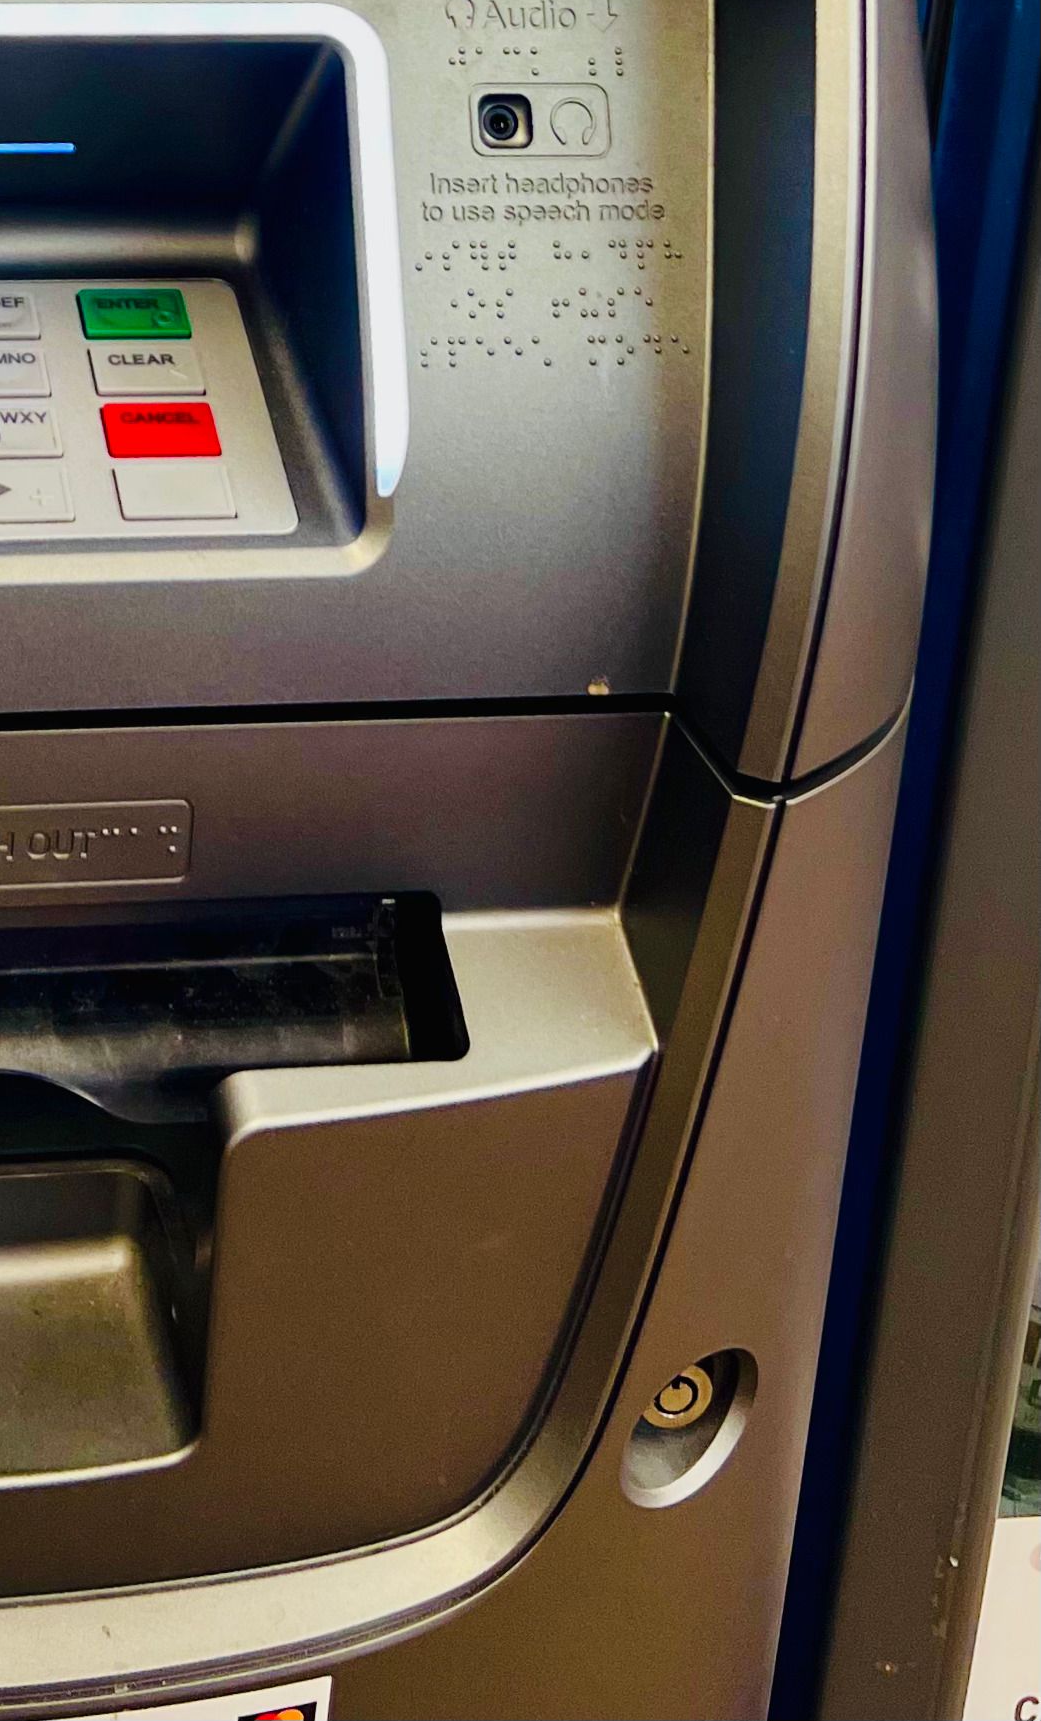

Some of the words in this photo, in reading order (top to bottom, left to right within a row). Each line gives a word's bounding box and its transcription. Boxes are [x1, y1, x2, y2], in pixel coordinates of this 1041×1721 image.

[430, 172, 498, 195] Insert
[505, 172, 655, 199] headphones
[421, 201, 444, 222] to
[452, 204, 496, 222] use
[503, 199, 591, 226] speech
[599, 199, 666, 222] mode
[96, 297, 160, 310] ENTER
[107, 354, 175, 366] CLEAR
[0, 411, 47, 424] WXY
[120, 412, 200, 425] CANCEL
[27, 830, 96, 860] OUT
